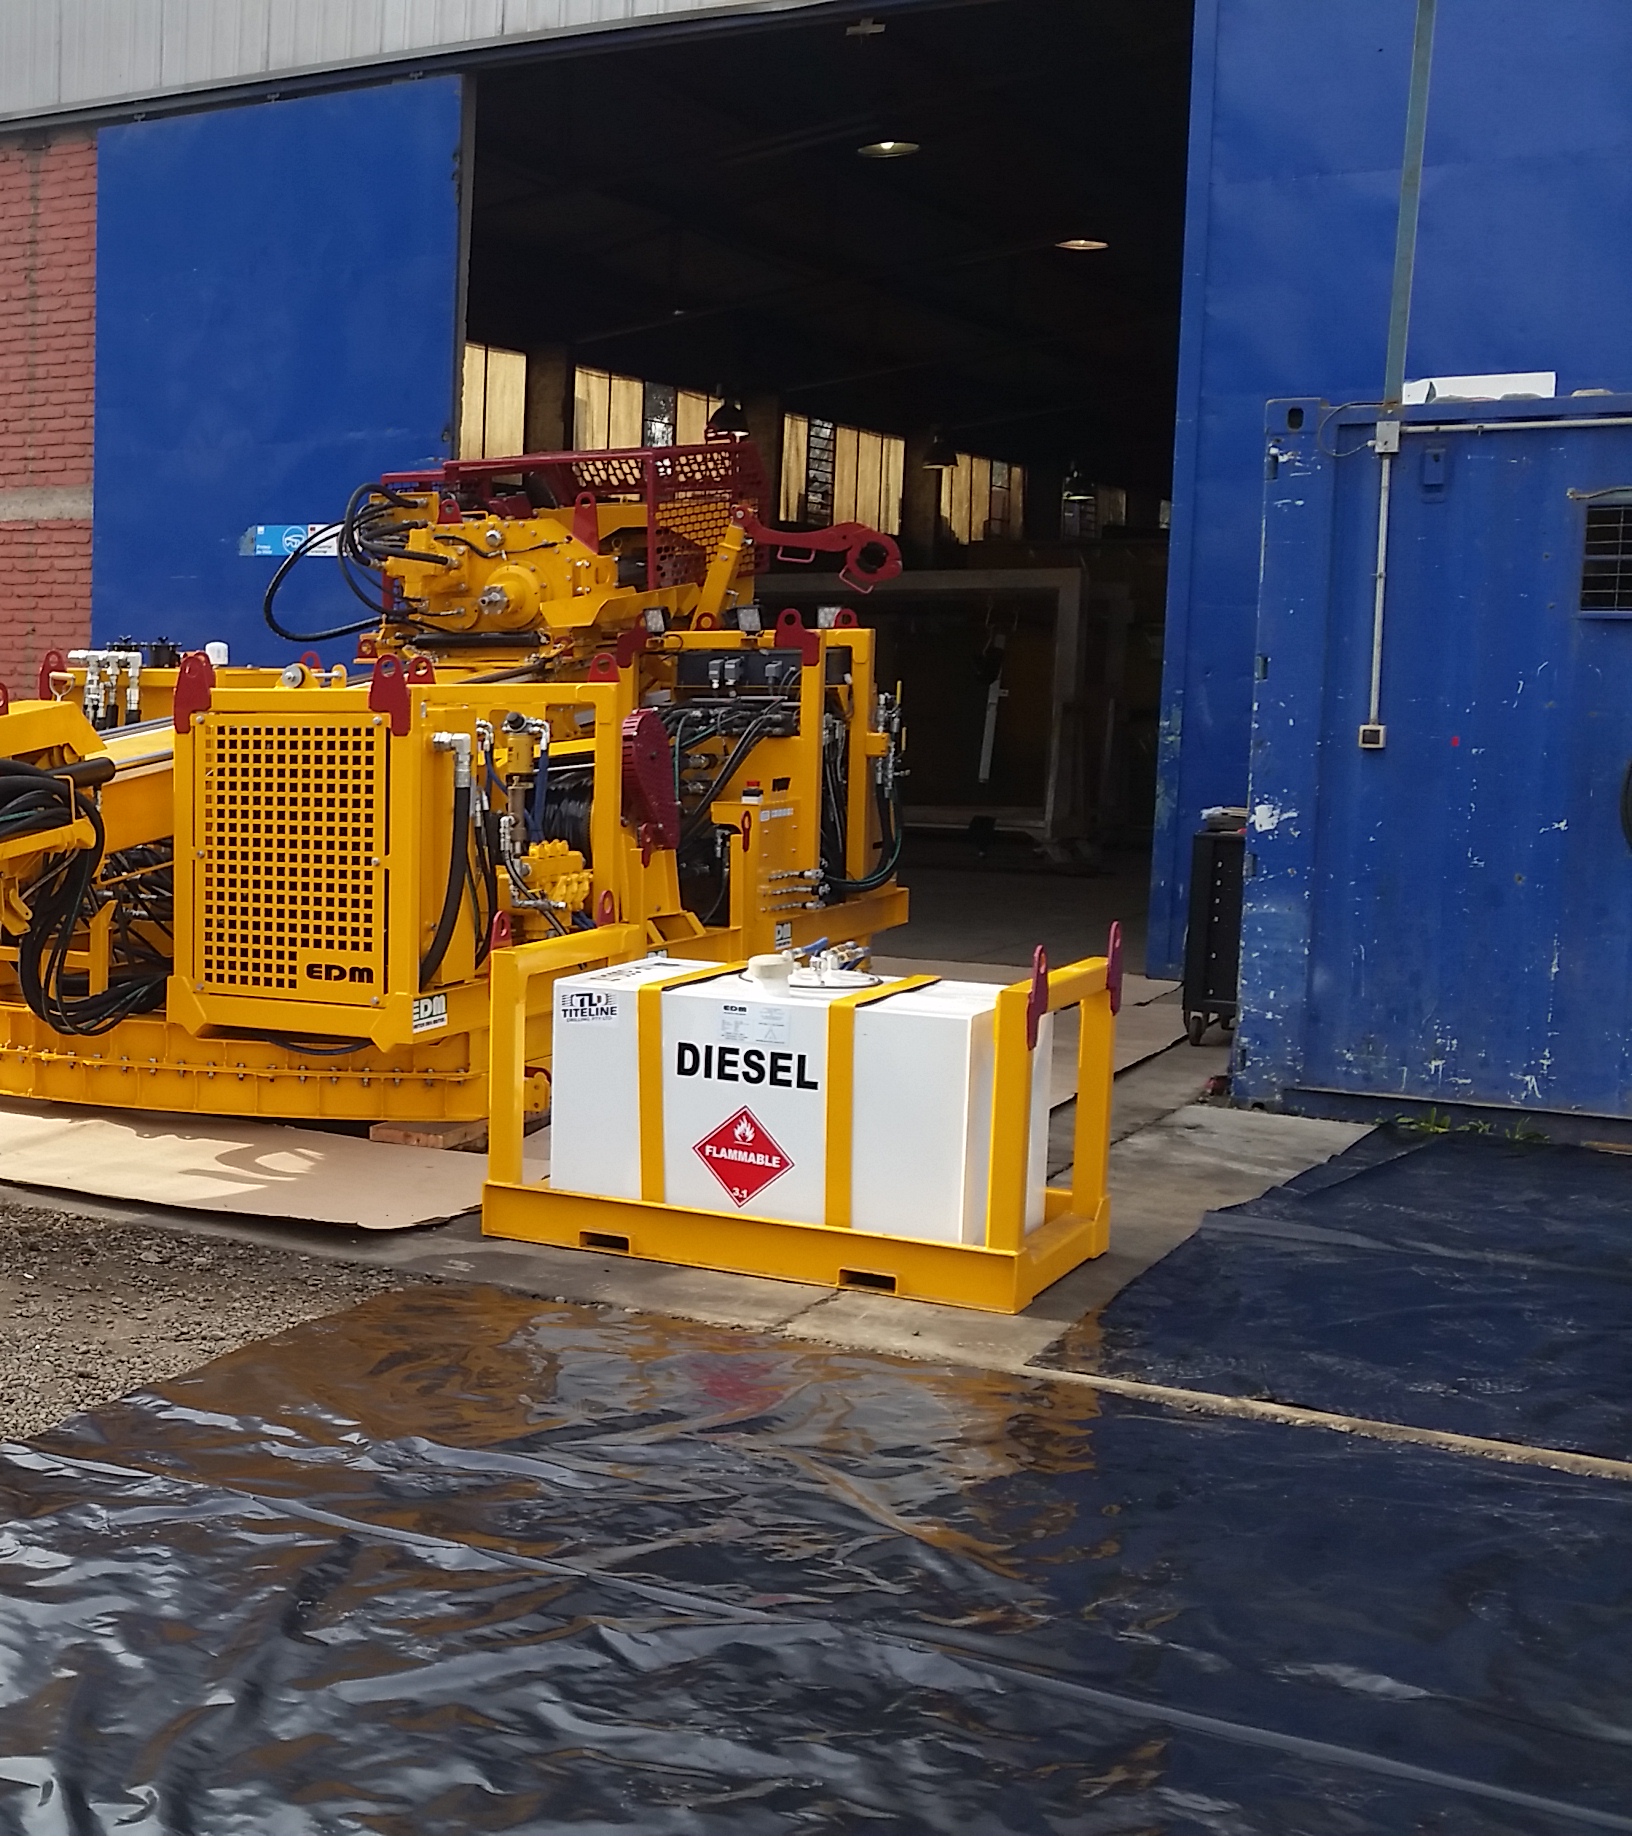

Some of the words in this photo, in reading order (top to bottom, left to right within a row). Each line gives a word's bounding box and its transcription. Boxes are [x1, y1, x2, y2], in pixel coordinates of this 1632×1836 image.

[306, 963, 374, 984] EDM
[561, 1006, 618, 1018] TITELINE
[677, 1042, 819, 1091] DIESEL
[705, 1144, 781, 1168] FLAMMABLE
[732, 1187, 748, 1198] 3.1
